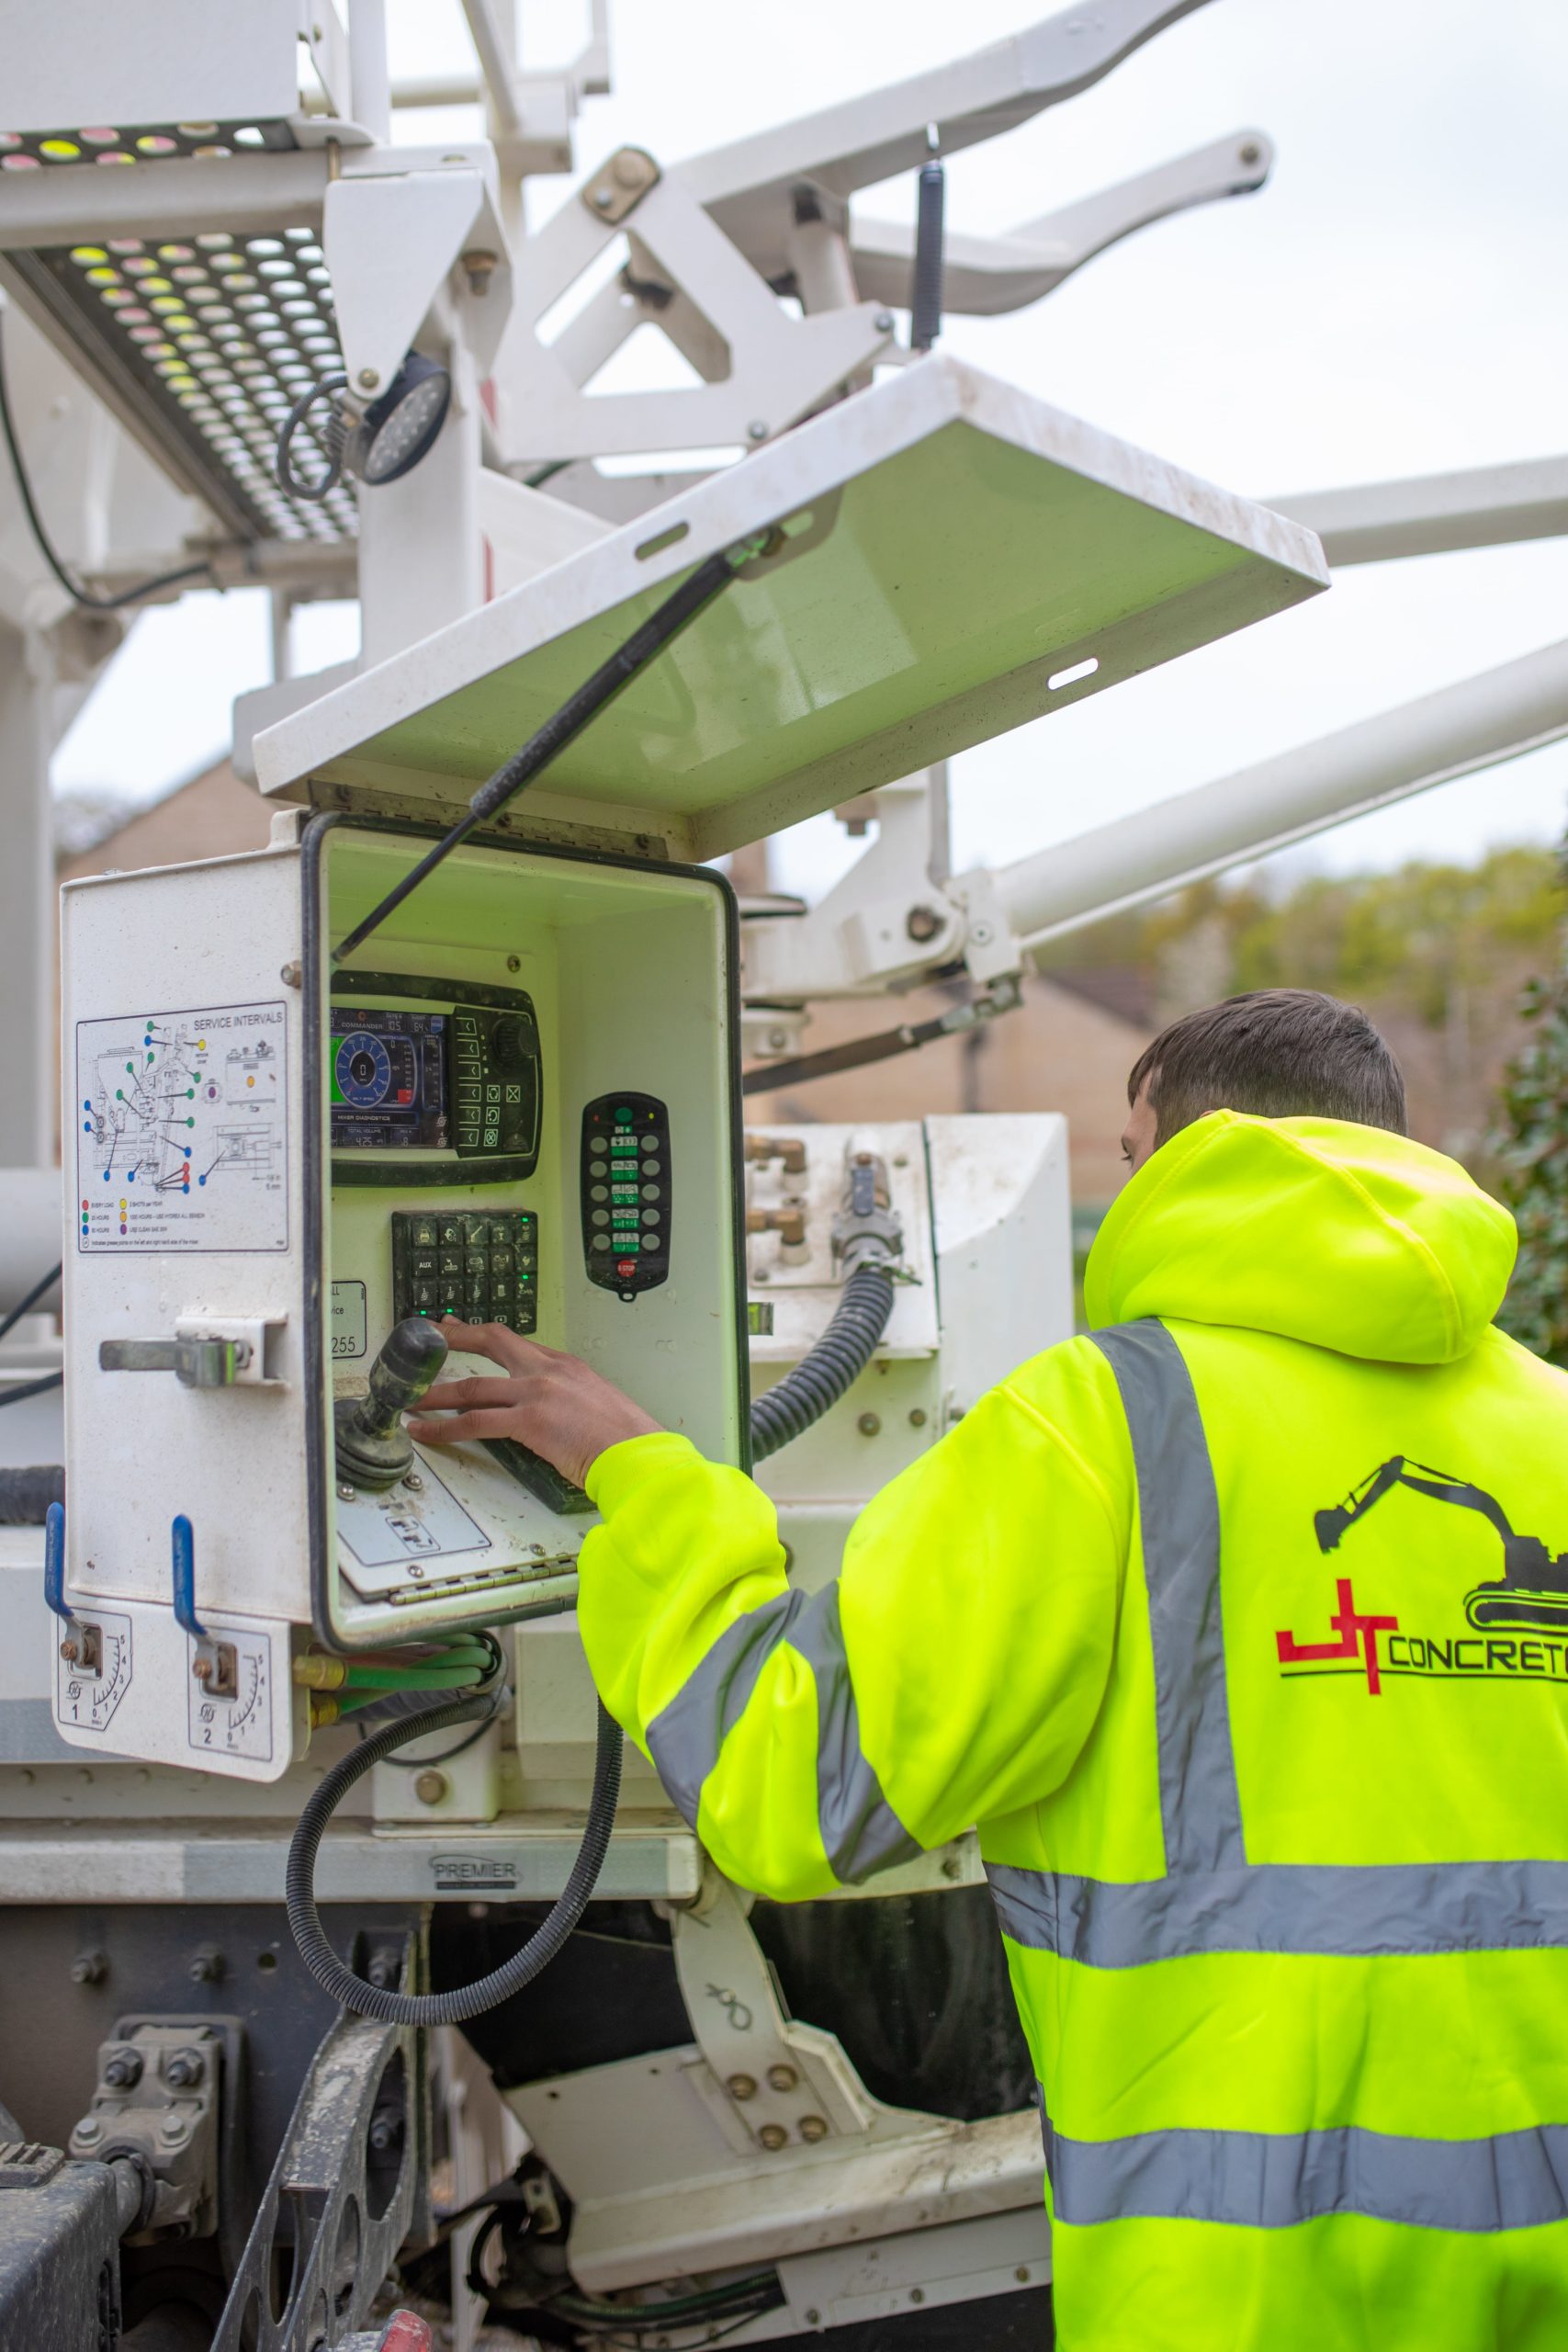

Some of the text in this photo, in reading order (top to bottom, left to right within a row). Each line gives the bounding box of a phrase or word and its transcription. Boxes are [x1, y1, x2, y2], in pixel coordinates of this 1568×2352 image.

[194, 1012, 283, 1031] SERVICE INTERVALS
[342, 1022, 383, 1030] COMMANDER
[360, 1065, 367, 1076] 0
[120, 1634, 125, 1645] 5
[121, 1655, 127, 1665] 4
[258, 1654, 263, 1665] 5
[1388, 1635, 1568, 1675] CONCRET
[119, 1674, 124, 1684] 3
[260, 1676, 265, 1686] 4
[113, 1690, 118, 1701] 2
[73, 1703, 77, 1720] 1
[92, 1708, 97, 1717] 0
[105, 1702, 108, 1712] 1
[251, 1713, 255, 1724] 2
[204, 1728, 211, 1744] 2
[241, 1725, 244, 1736] 1
[227, 1732, 232, 1742] 0
[434, 1863, 516, 1878] PREMIER
